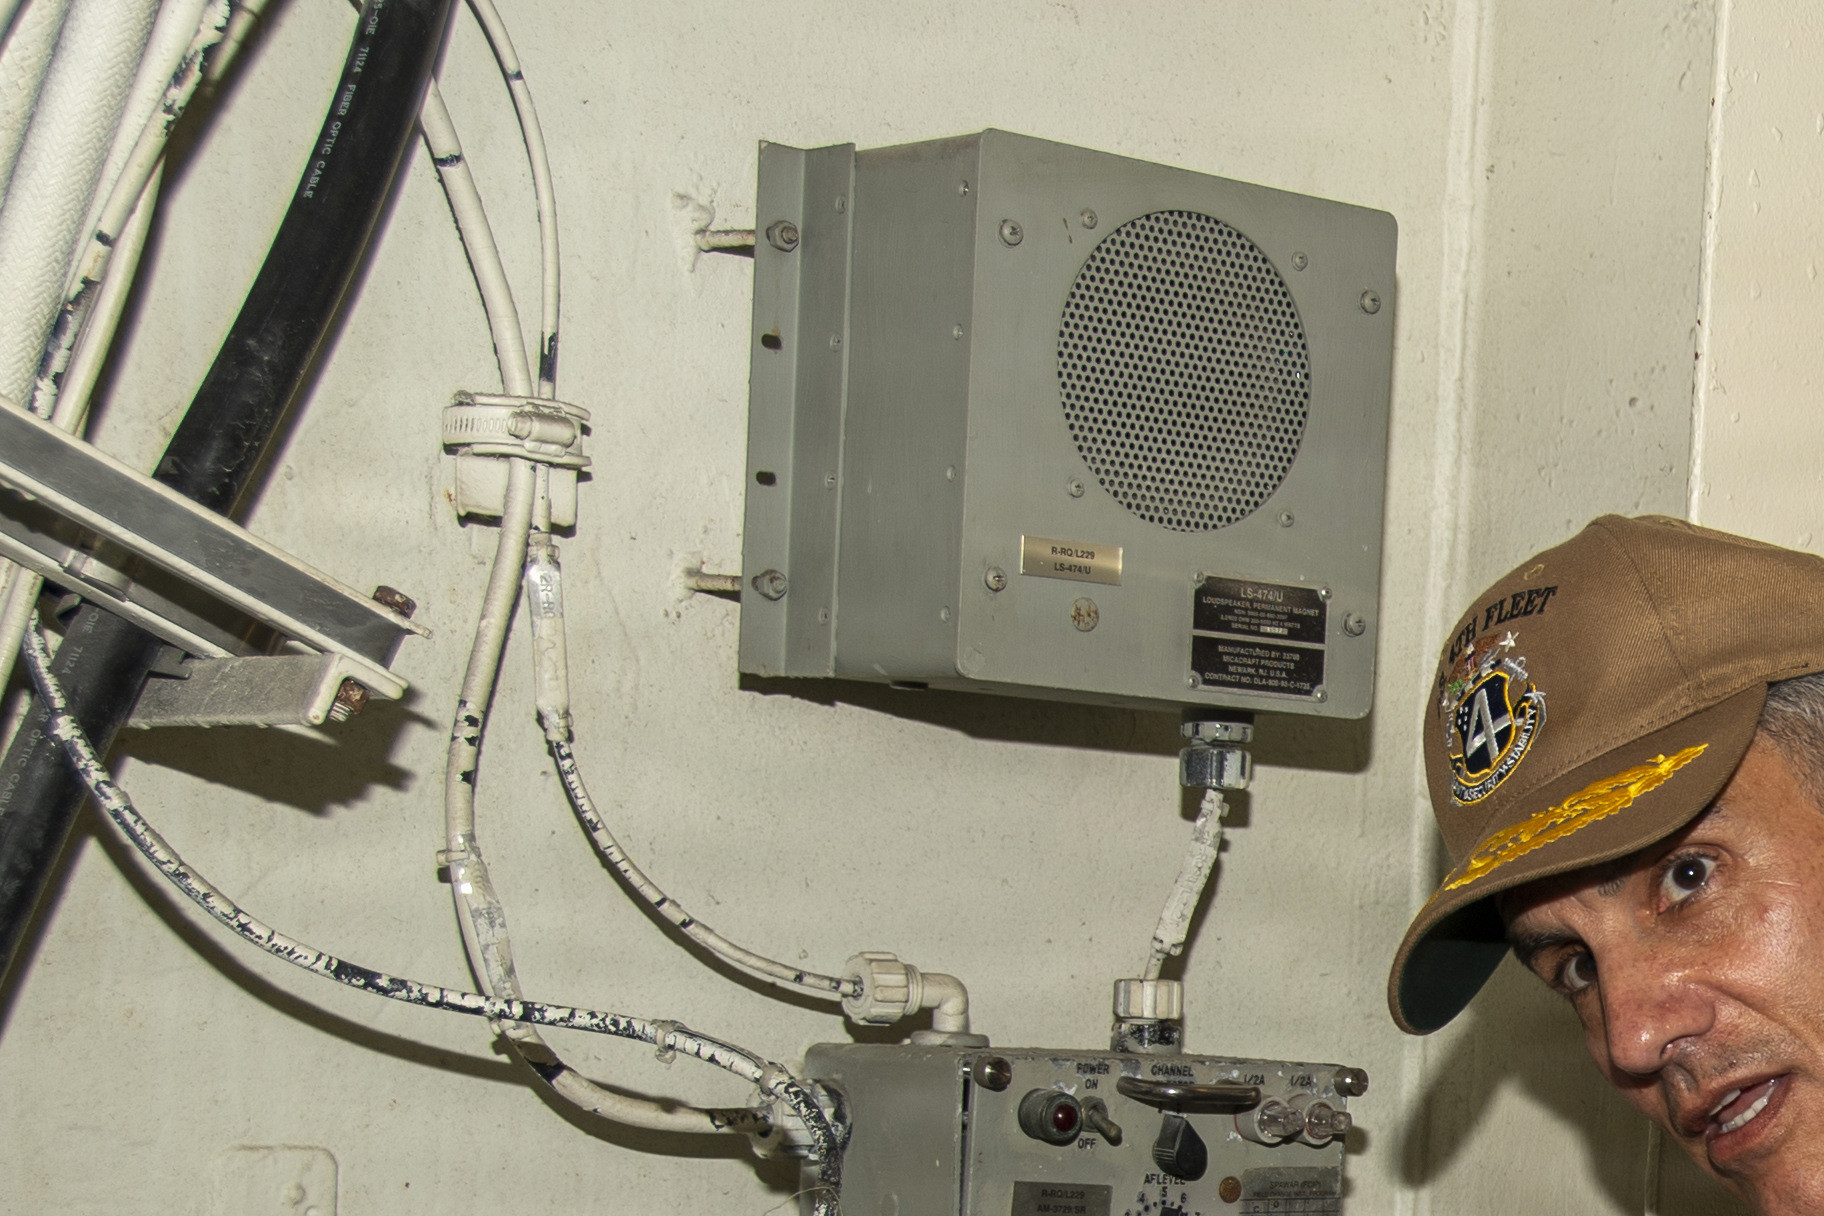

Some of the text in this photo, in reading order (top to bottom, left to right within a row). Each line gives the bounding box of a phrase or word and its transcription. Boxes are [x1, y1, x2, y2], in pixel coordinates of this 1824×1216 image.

[303, 46, 370, 199] 71124 FIBER OPTIC CABLE
[1054, 562, 1091, 575] LS-474/U
[1240, 586, 1285, 602] LS-474/U
[1253, 602, 1292, 613] PERMANENT
[1482, 586, 1558, 631] FLEET
[1218, 645, 1269, 658] MANUFACTURED
[1261, 659, 1295, 669] PRODUCTS
[1204, 671, 1240, 683] CONTRACT
[18, 729, 41, 767] OPTIC
[1077, 1063, 1110, 1075] POWER
[1151, 1063, 1194, 1077] CHANNEL
[1085, 1079, 1099, 1090] ON
[1244, 1074, 1265, 1087] 1/2A
[1290, 1075, 1312, 1087] 1/2A
[1078, 1139, 1097, 1150] OFF
[1138, 1191, 1146, 1203] 4
[1160, 1186, 1168, 1197] 5
[1180, 1192, 1187, 1203] 6
